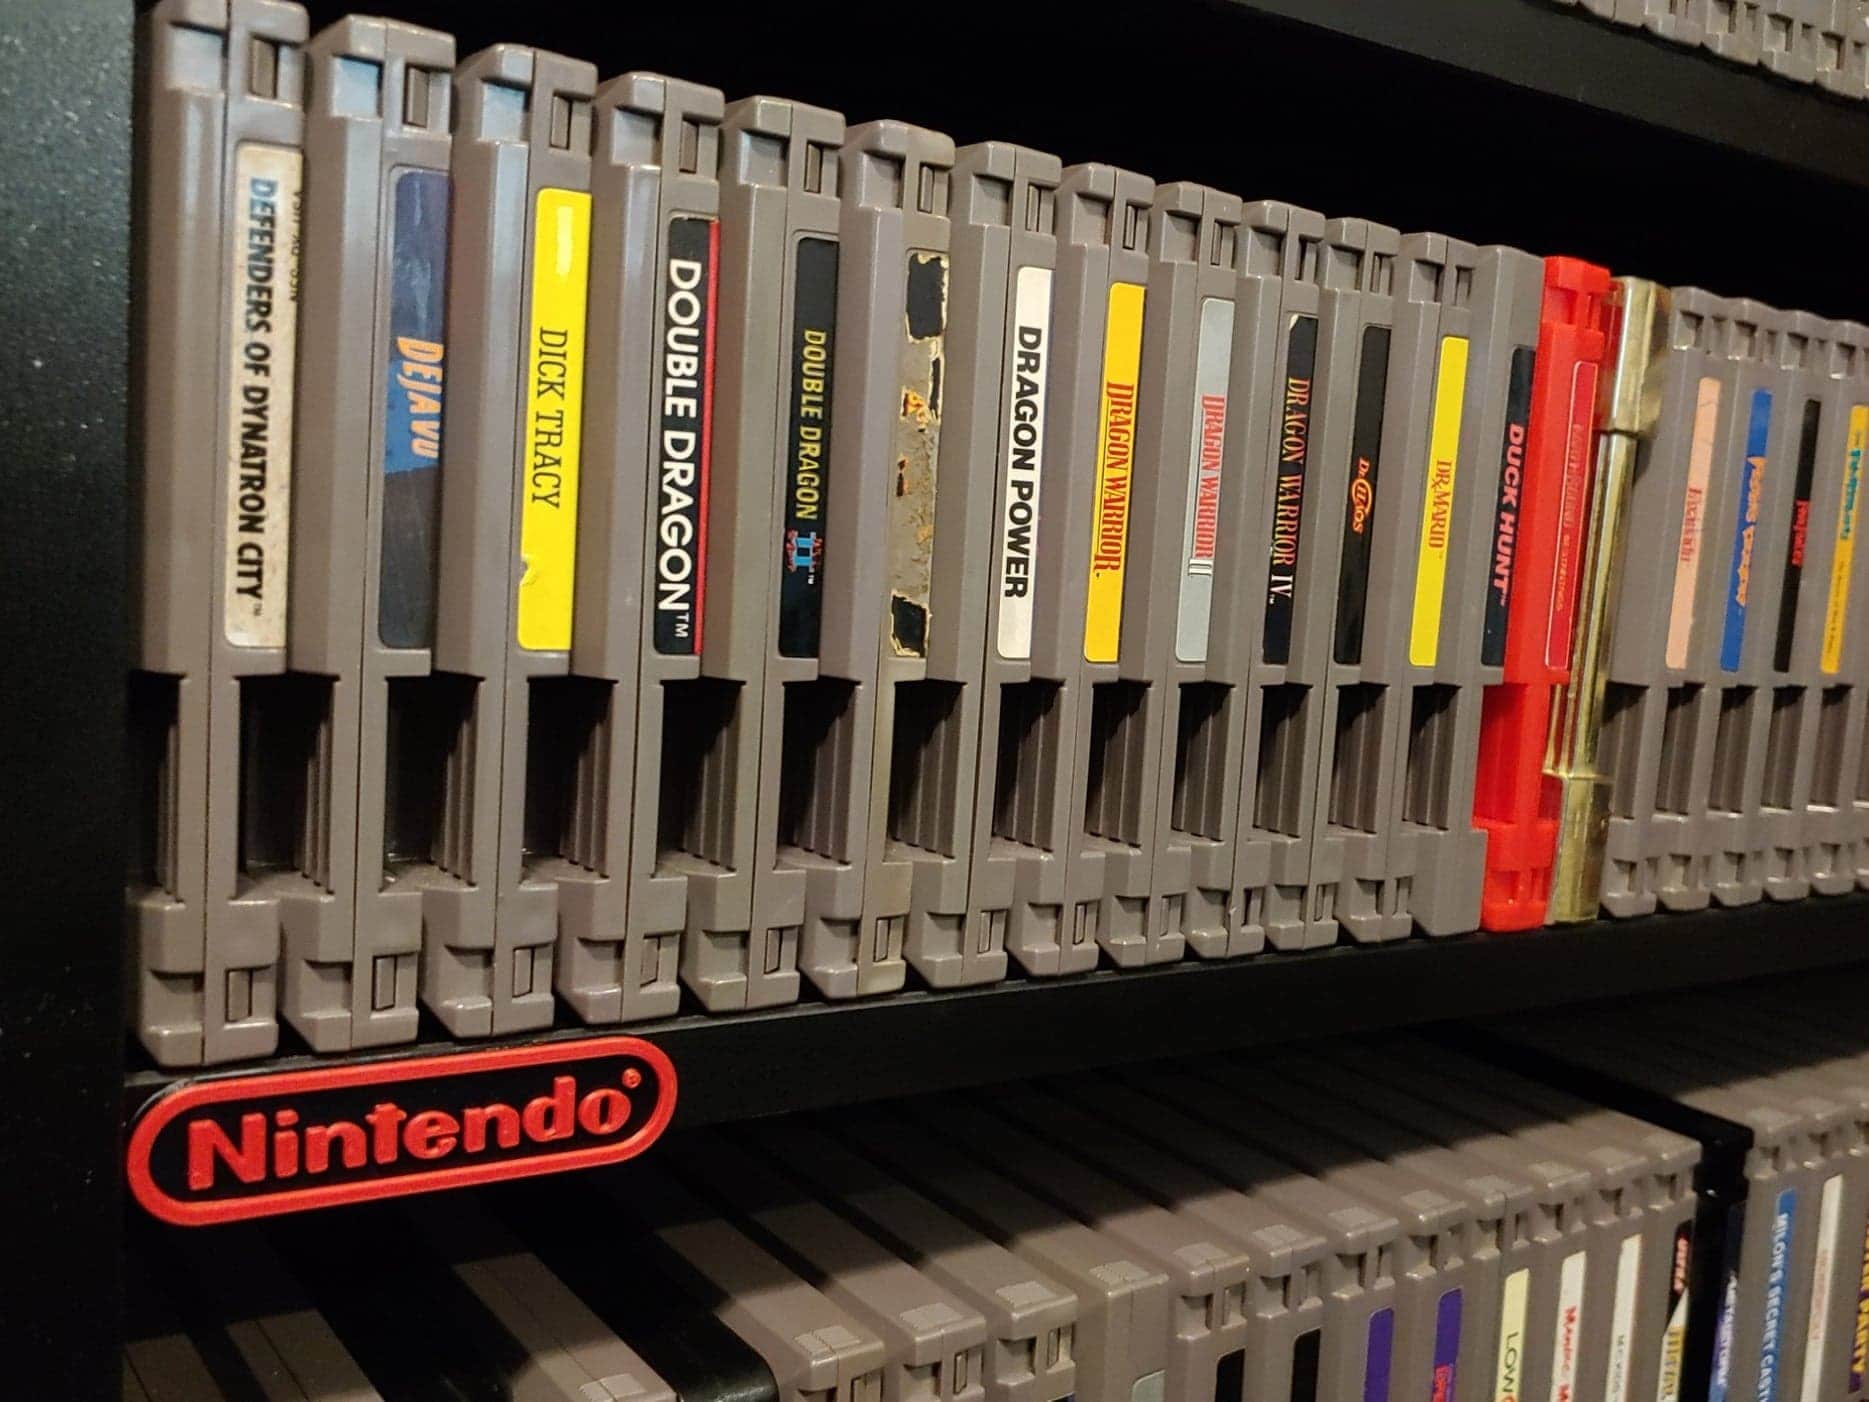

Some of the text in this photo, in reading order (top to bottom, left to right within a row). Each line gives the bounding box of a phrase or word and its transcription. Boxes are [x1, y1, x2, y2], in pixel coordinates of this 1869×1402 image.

[243, 177, 279, 337] DEFENDERS
[242, 342, 270, 380] OF
[665, 258, 702, 416] DOUBLE
[799, 329, 826, 418] DOUBLE
[238, 385, 269, 532] DYNATRON
[411, 420, 440, 459] VU
[532, 326, 568, 510] DICK TRACY
[1005, 326, 1041, 599] DRAGON POWER
[1105, 381, 1134, 470] DRAGON
[1202, 394, 1225, 470] DRAGON
[1282, 376, 1310, 465] DRAGON
[796, 425, 821, 519] DRAGON
[1502, 424, 1525, 507] DUCK
[1194, 475, 1220, 558] WARRIOR
[1272, 474, 1302, 565] WARRIOR
[1763, 1286, 1782, 1351] SECRET
